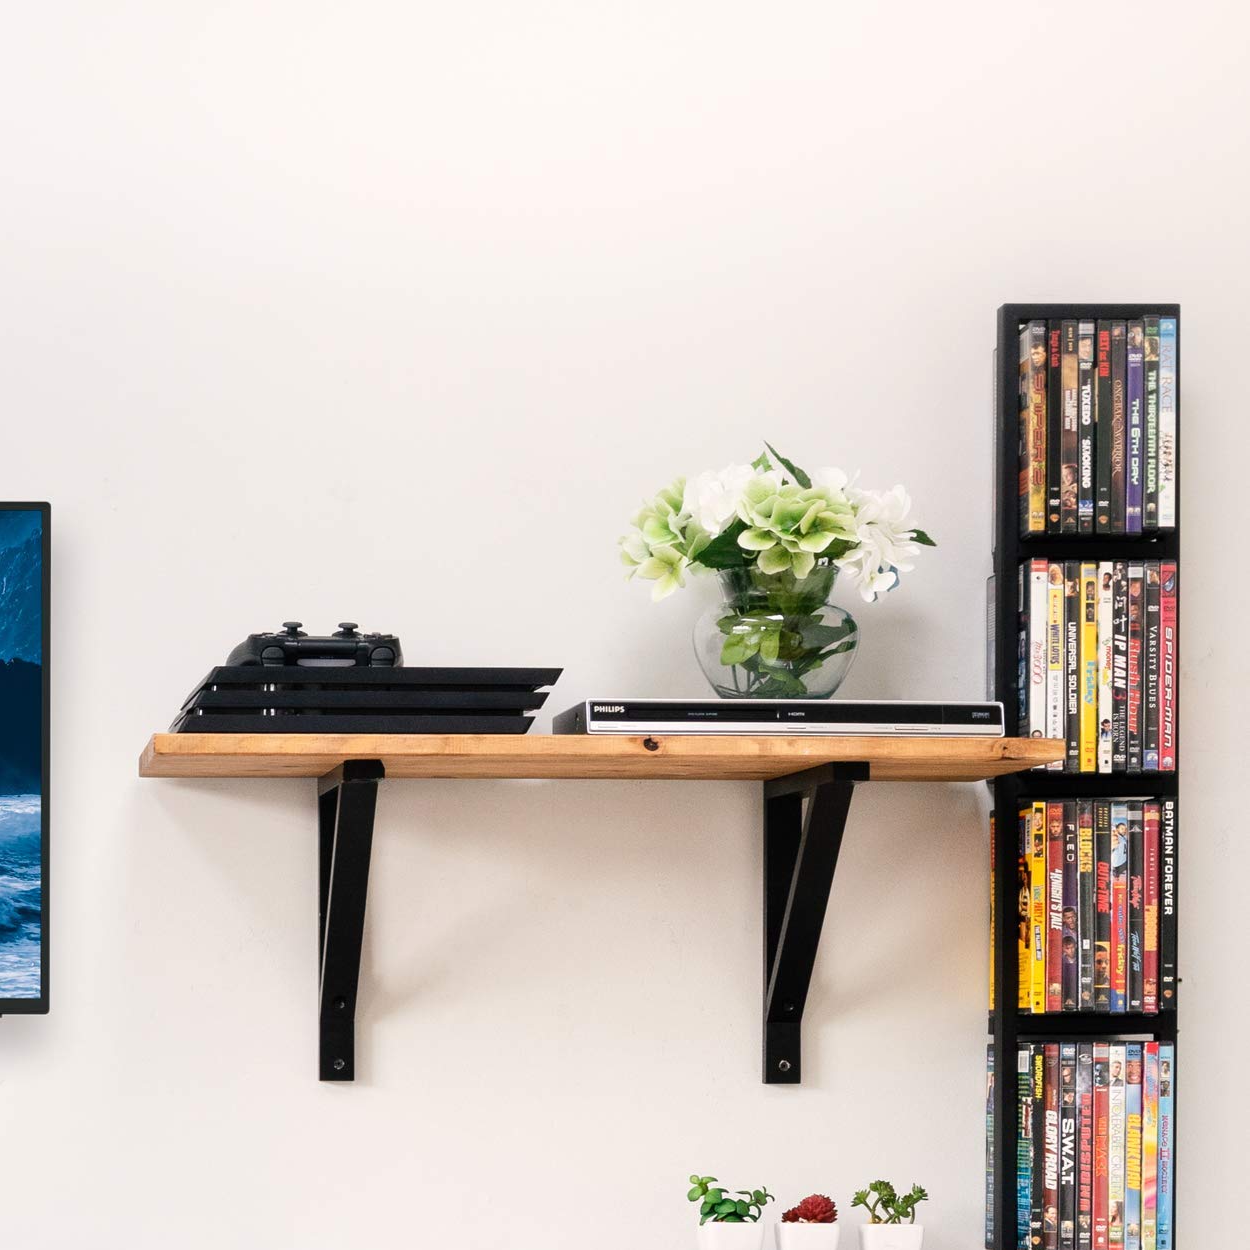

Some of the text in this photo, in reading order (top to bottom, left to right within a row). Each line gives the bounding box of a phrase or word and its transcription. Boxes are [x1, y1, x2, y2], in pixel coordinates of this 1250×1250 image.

[1162, 345, 1172, 412] RAT RACE
[1033, 373, 1044, 486] SNIPER 2
[1082, 384, 1091, 488] TUXEDO SMOKING
[1132, 428, 1140, 455] 6TH
[1147, 370, 1156, 493] THE THIRTEENTH FLOOR
[1131, 457, 1139, 485] DAY
[1050, 624, 1059, 644] WHITE
[1050, 645, 1060, 664] LOTUS
[1069, 622, 1077, 714] UNIVERSAL SOLDIER
[1113, 635, 1126, 701] IP MAN 3
[1149, 625, 1157, 708] VARSITY BLUES
[1129, 638, 1140, 734] Rush Hour
[1164, 626, 1173, 749] SPIDER-MAN
[1066, 824, 1074, 862] FLED
[1165, 801, 1173, 914] BATMAN FOREVER
[1045, 1110, 1058, 1190] GLORY ROAD
[1062, 1118, 1074, 1185] S.W.A.T.
[1080, 1093, 1091, 1211] UNDISPUTED
[1111, 1089, 1122, 1196] INTOLERABLE CRUELTY
[1127, 1113, 1140, 1190] BLANKMAN
